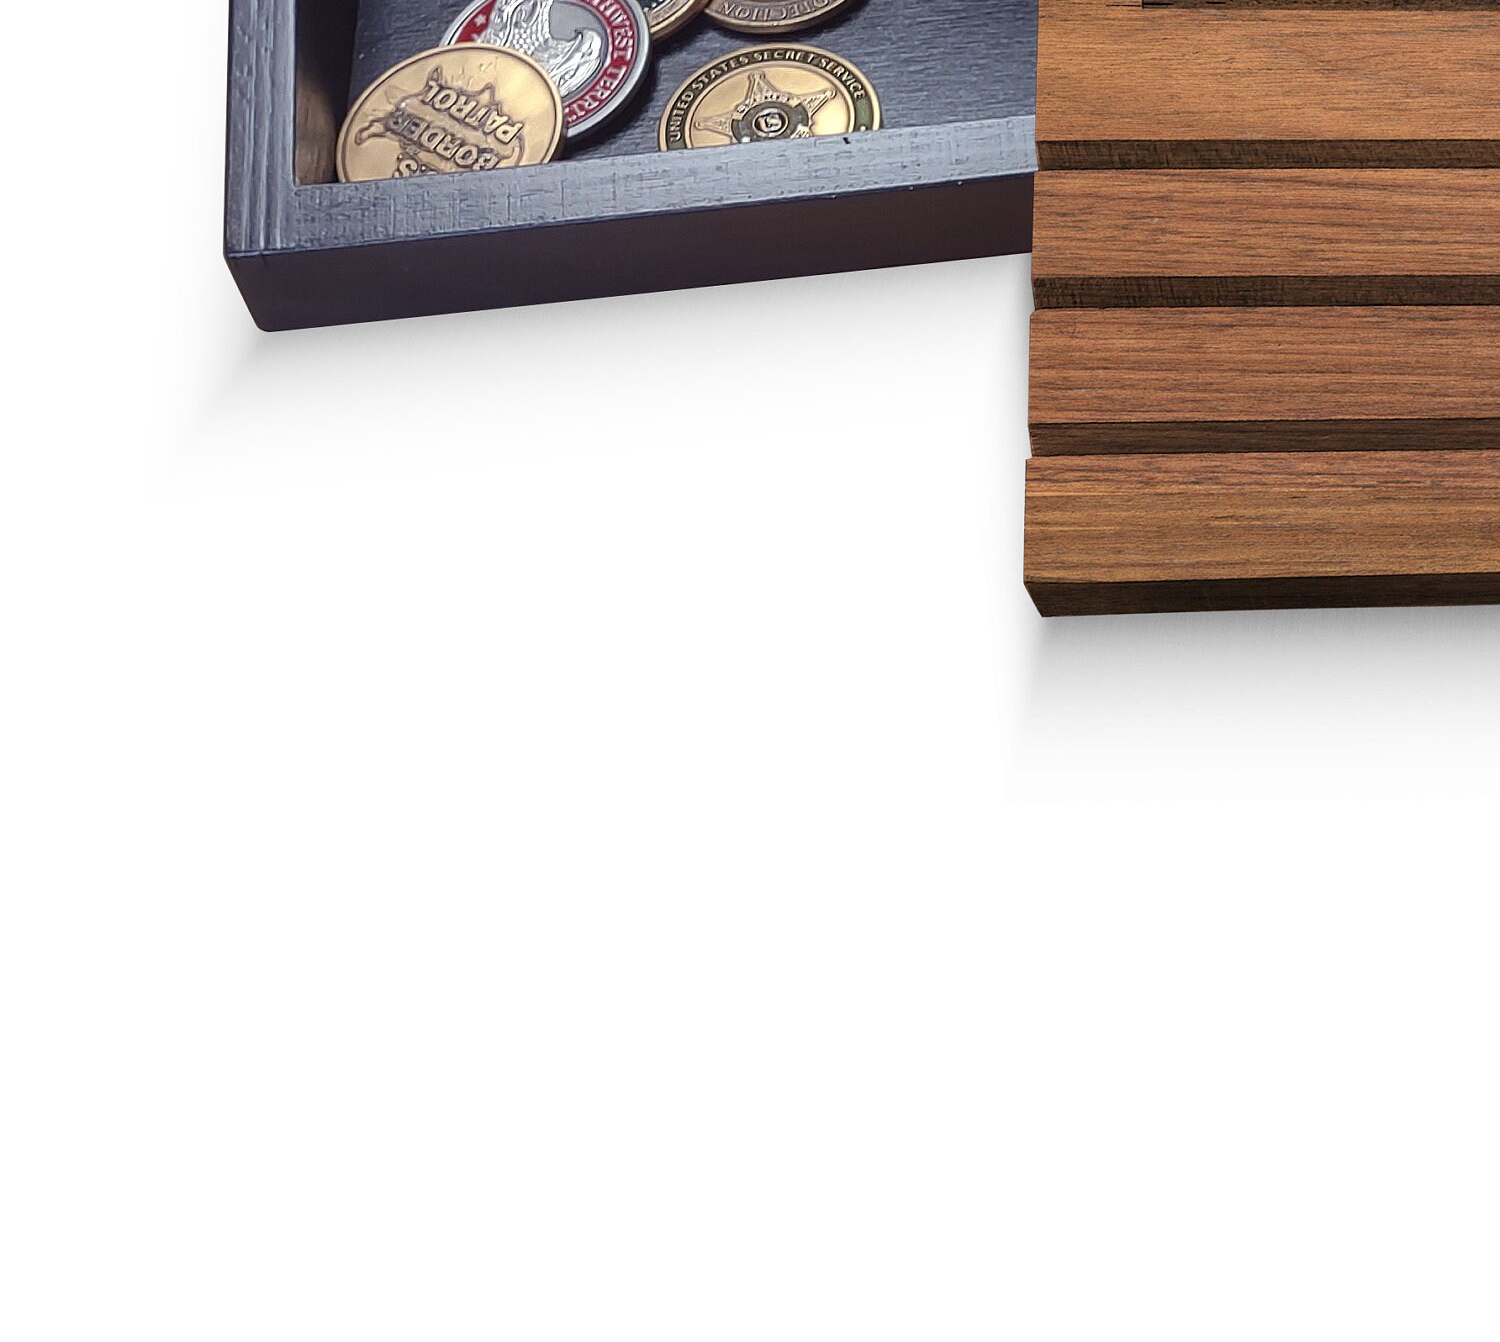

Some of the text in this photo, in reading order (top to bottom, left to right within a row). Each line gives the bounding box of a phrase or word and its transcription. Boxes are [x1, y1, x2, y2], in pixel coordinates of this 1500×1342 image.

[420, 79, 524, 145] PATROL
[669, 90, 694, 143] UNITED
[692, 56, 750, 90] STATES
[753, 49, 815, 64] SECRET
[818, 57, 867, 101] SERVICE
[390, 111, 500, 171] BORDER
